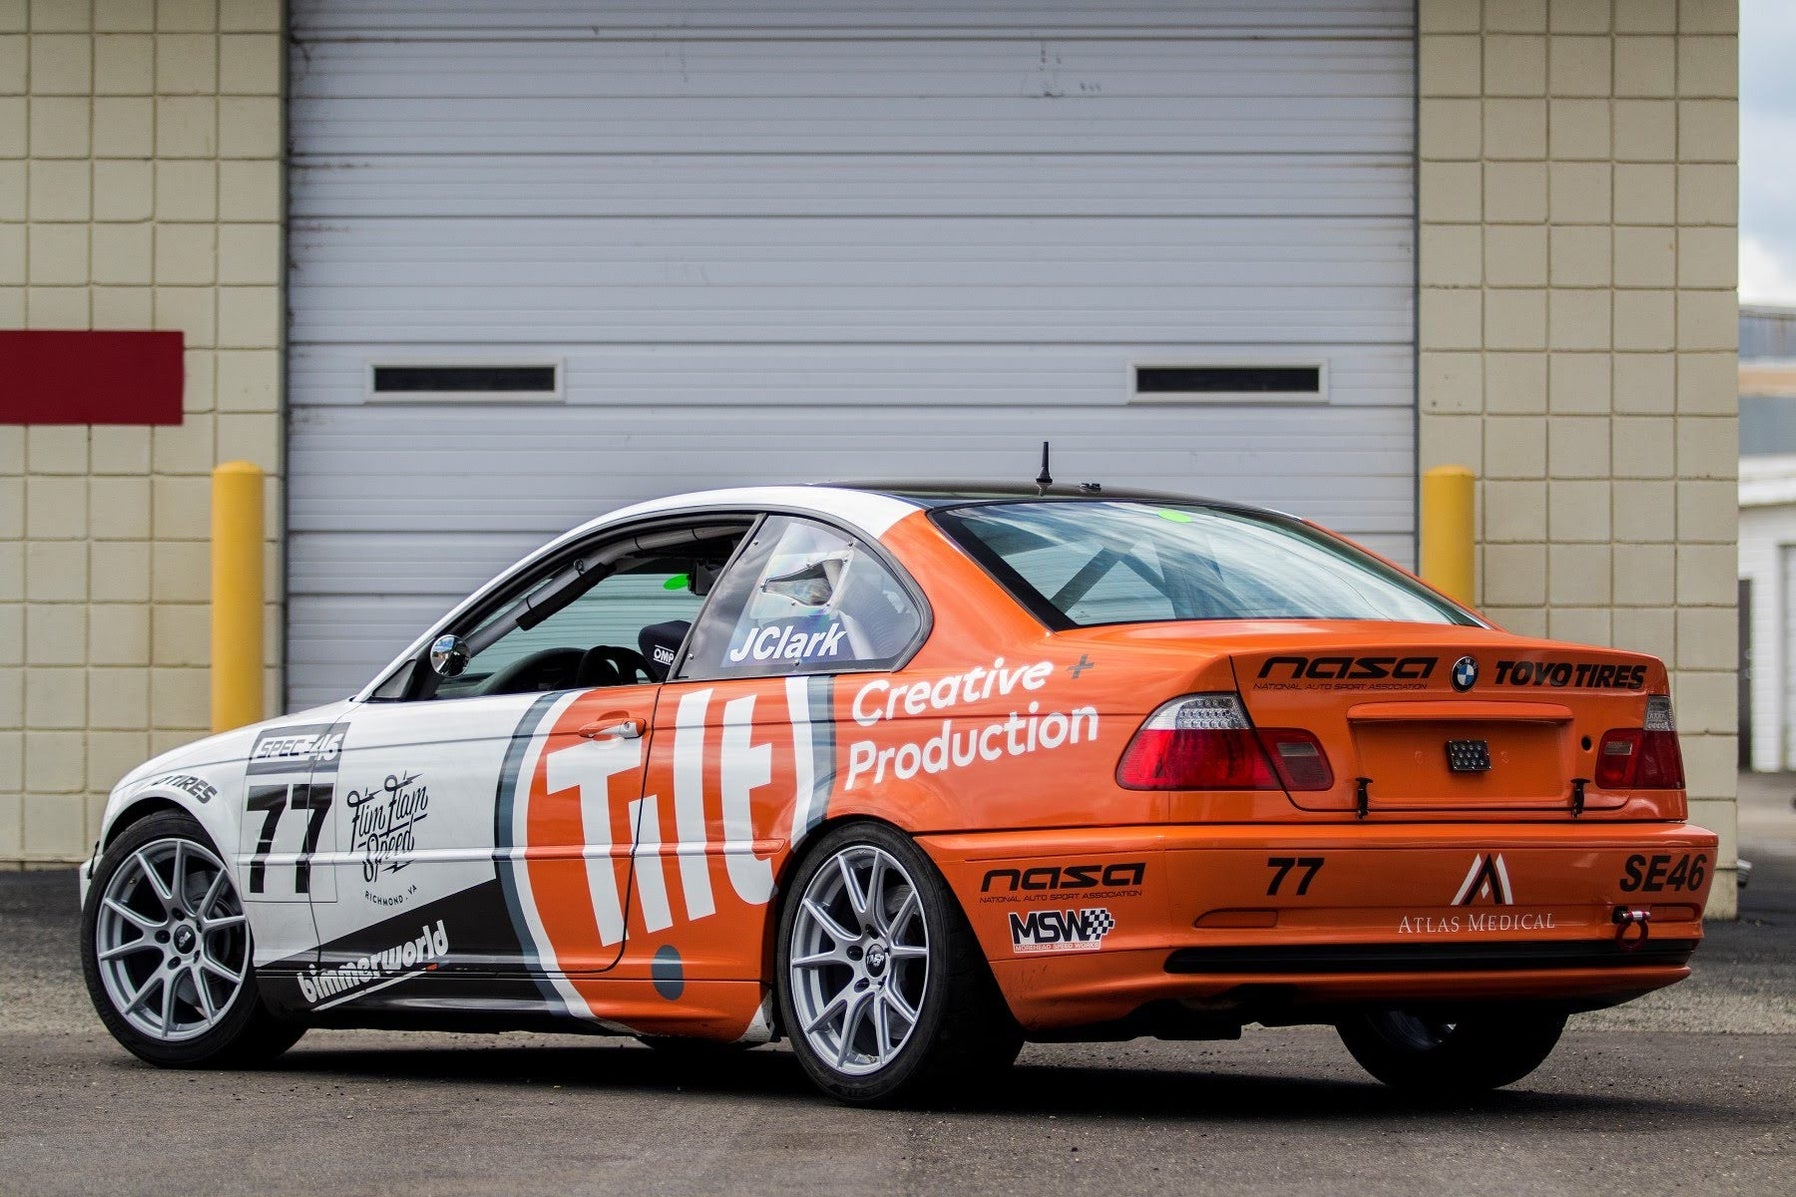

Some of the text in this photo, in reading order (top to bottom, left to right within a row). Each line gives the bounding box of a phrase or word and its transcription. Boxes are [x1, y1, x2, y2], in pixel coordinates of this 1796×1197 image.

[654, 647, 675, 663] OMP
[730, 623, 847, 662] JClark
[852, 657, 1054, 727] Creative
[1253, 682, 1428, 690] NATIONAL AUTO SPORT ASSOCIATION
[1495, 660, 1648, 690] TOYO TIRES
[844, 701, 1099, 791] Production
[546, 687, 779, 948] Tilt
[246, 783, 335, 894] 77
[362, 813, 415, 883] Speed
[1266, 857, 1325, 896] 77
[1620, 854, 1707, 892] SE46
[364, 890, 404, 906] RICHMOND
[979, 896, 1021, 904] NATIONAL
[1050, 892, 1081, 900] SPORT
[1082, 889, 1143, 899] ASSOCIATION
[1009, 910, 1091, 944] MSW
[297, 919, 449, 1003] bimmerworld
